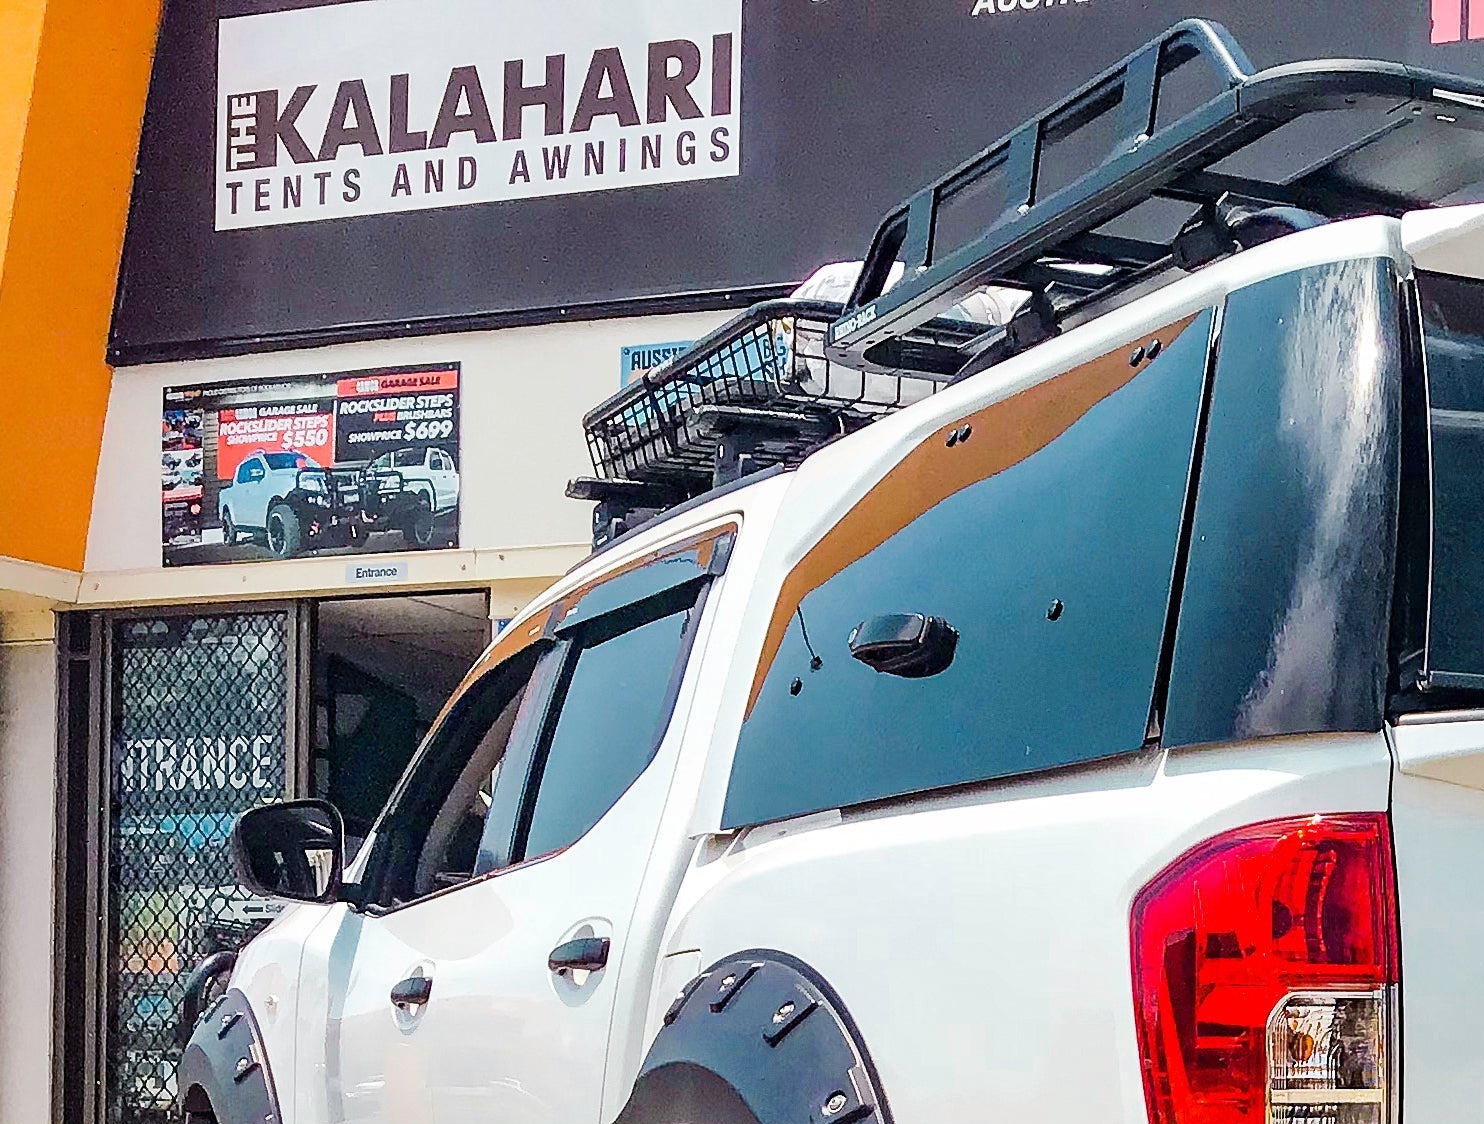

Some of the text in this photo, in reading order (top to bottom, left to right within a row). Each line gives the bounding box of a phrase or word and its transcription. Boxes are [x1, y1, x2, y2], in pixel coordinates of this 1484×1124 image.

[229, 33, 733, 170] THE KALAHARI
[226, 126, 731, 215] TENTS AND AWNINGS
[631, 346, 688, 371] AUSS
[419, 376, 441, 386] SALE
[258, 405, 296, 416] GARAGE
[296, 403, 319, 414] SALE
[340, 393, 454, 415] ROCKSLIDER STEPS
[219, 414, 330, 436] ROCKSLIDER STEPS
[403, 420, 454, 441] $699
[281, 429, 329, 450] $550
[355, 566, 398, 579] Entrance
